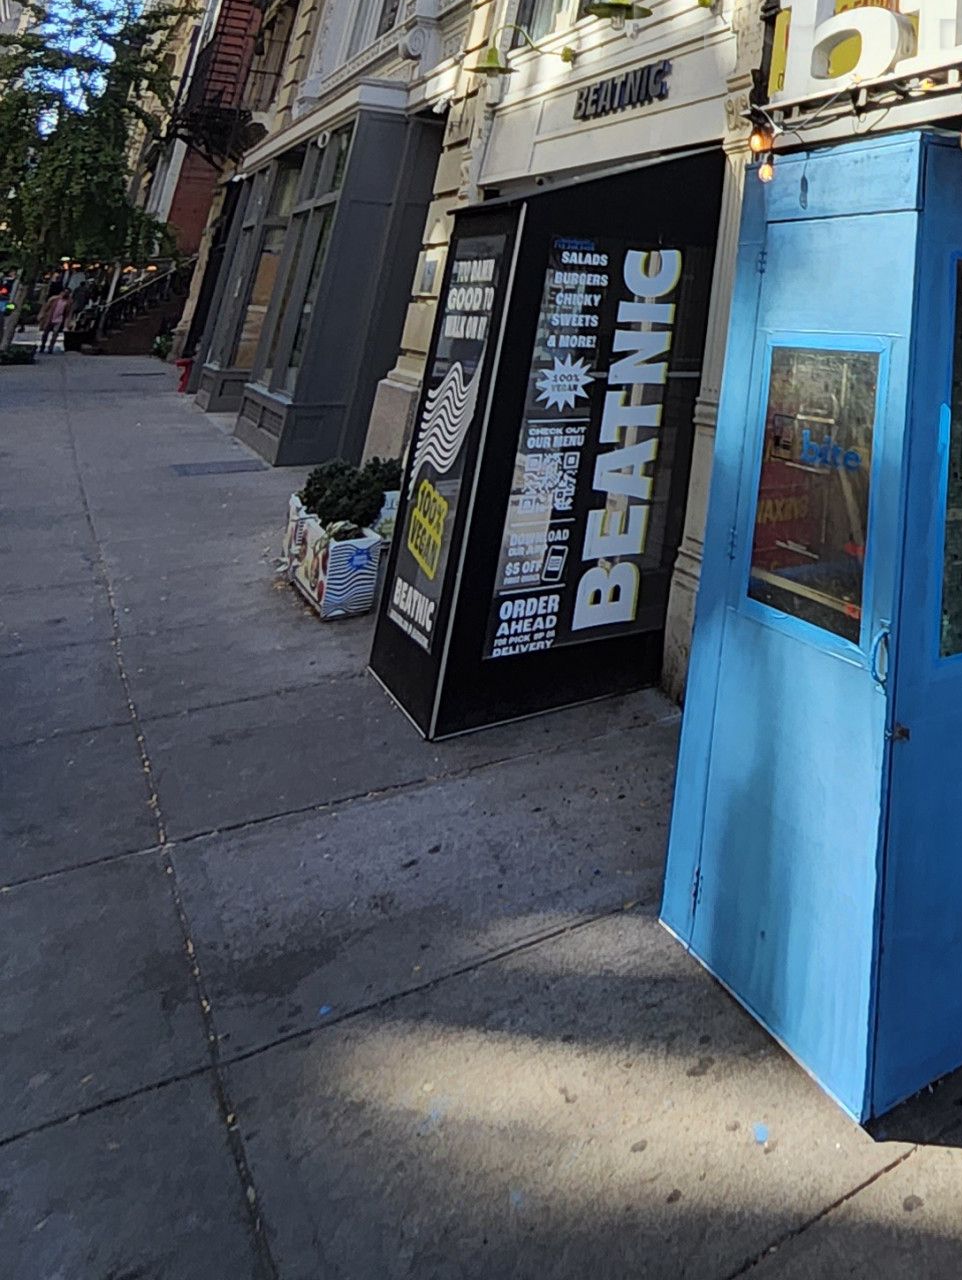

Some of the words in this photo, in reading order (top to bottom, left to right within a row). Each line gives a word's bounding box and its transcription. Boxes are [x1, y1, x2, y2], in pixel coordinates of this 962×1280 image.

[572, 59, 673, 121] BEATNIC
[561, 250, 609, 266] SALADS
[554, 272, 609, 286] BURGERS
[447, 286, 482, 311] GOOD
[555, 292, 602, 307] CHICKY
[551, 314, 599, 328] SWEETS
[559, 335, 597, 348] MORE!
[528, 427, 563, 436] CHECK
[565, 426, 587, 434] OUT
[527, 436, 550, 449] OUR
[552, 435, 585, 448] MENU
[571, 248, 684, 632] BEATNIC
[801, 428, 862, 471] bite
[509, 529, 570, 546] DOWNLOAD
[504, 562, 520, 577] $5
[521, 561, 543, 574] OFF
[392, 575, 436, 632] BEATNIC
[499, 594, 560, 620] ORDER
[495, 615, 557, 637] AHEAD
[508, 633, 531, 645] PICK
[491, 638, 554, 658] DELIVERY
